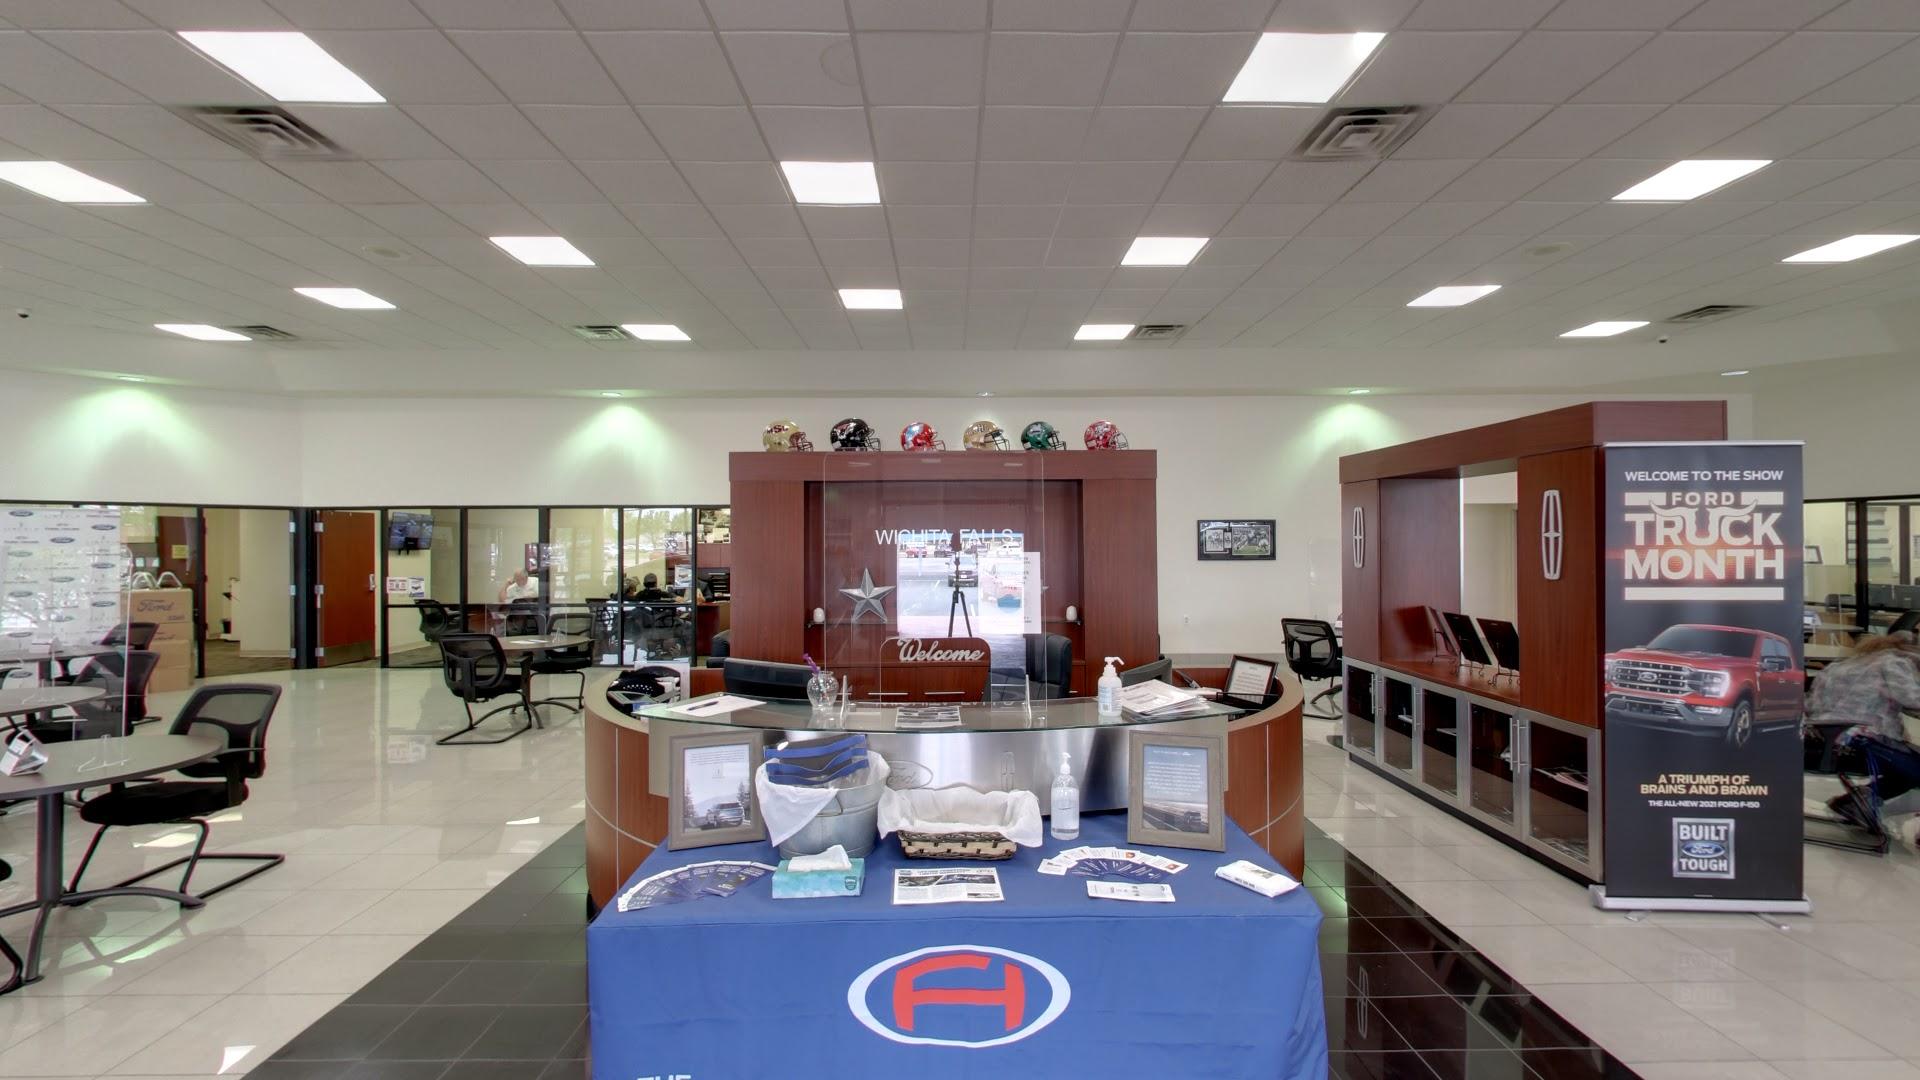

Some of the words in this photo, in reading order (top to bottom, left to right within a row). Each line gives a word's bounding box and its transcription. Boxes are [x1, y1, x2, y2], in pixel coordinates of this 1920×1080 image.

[1625, 471, 1689, 482] WELCOME
[1691, 471, 1712, 481] TO
[1714, 470, 1740, 481] THE
[1743, 470, 1784, 481] SHOW
[1672, 492, 1735, 506] FORD
[1624, 507, 1782, 546] TRUCK
[875, 529, 952, 546] WICHITA
[959, 528, 1014, 545] FALLS
[1624, 549, 1784, 580] MONTH
[896, 638, 985, 662] Welcome
[1658, 774, 1668, 784] A
[1668, 774, 1730, 785] TRIUMPH
[1732, 774, 1750, 785] OF
[1640, 784, 1687, 795] BRAINS
[1688, 784, 1719, 796] AND
[1720, 785, 1769, 796] BRAWN
[1664, 800, 1698, 808] ALL-NEW
[1699, 800, 1717, 808] 2021
[1679, 824, 1728, 841] BUILT
[1690, 845, 1715, 854] Ford
[1679, 858, 1728, 872] TOUGH
